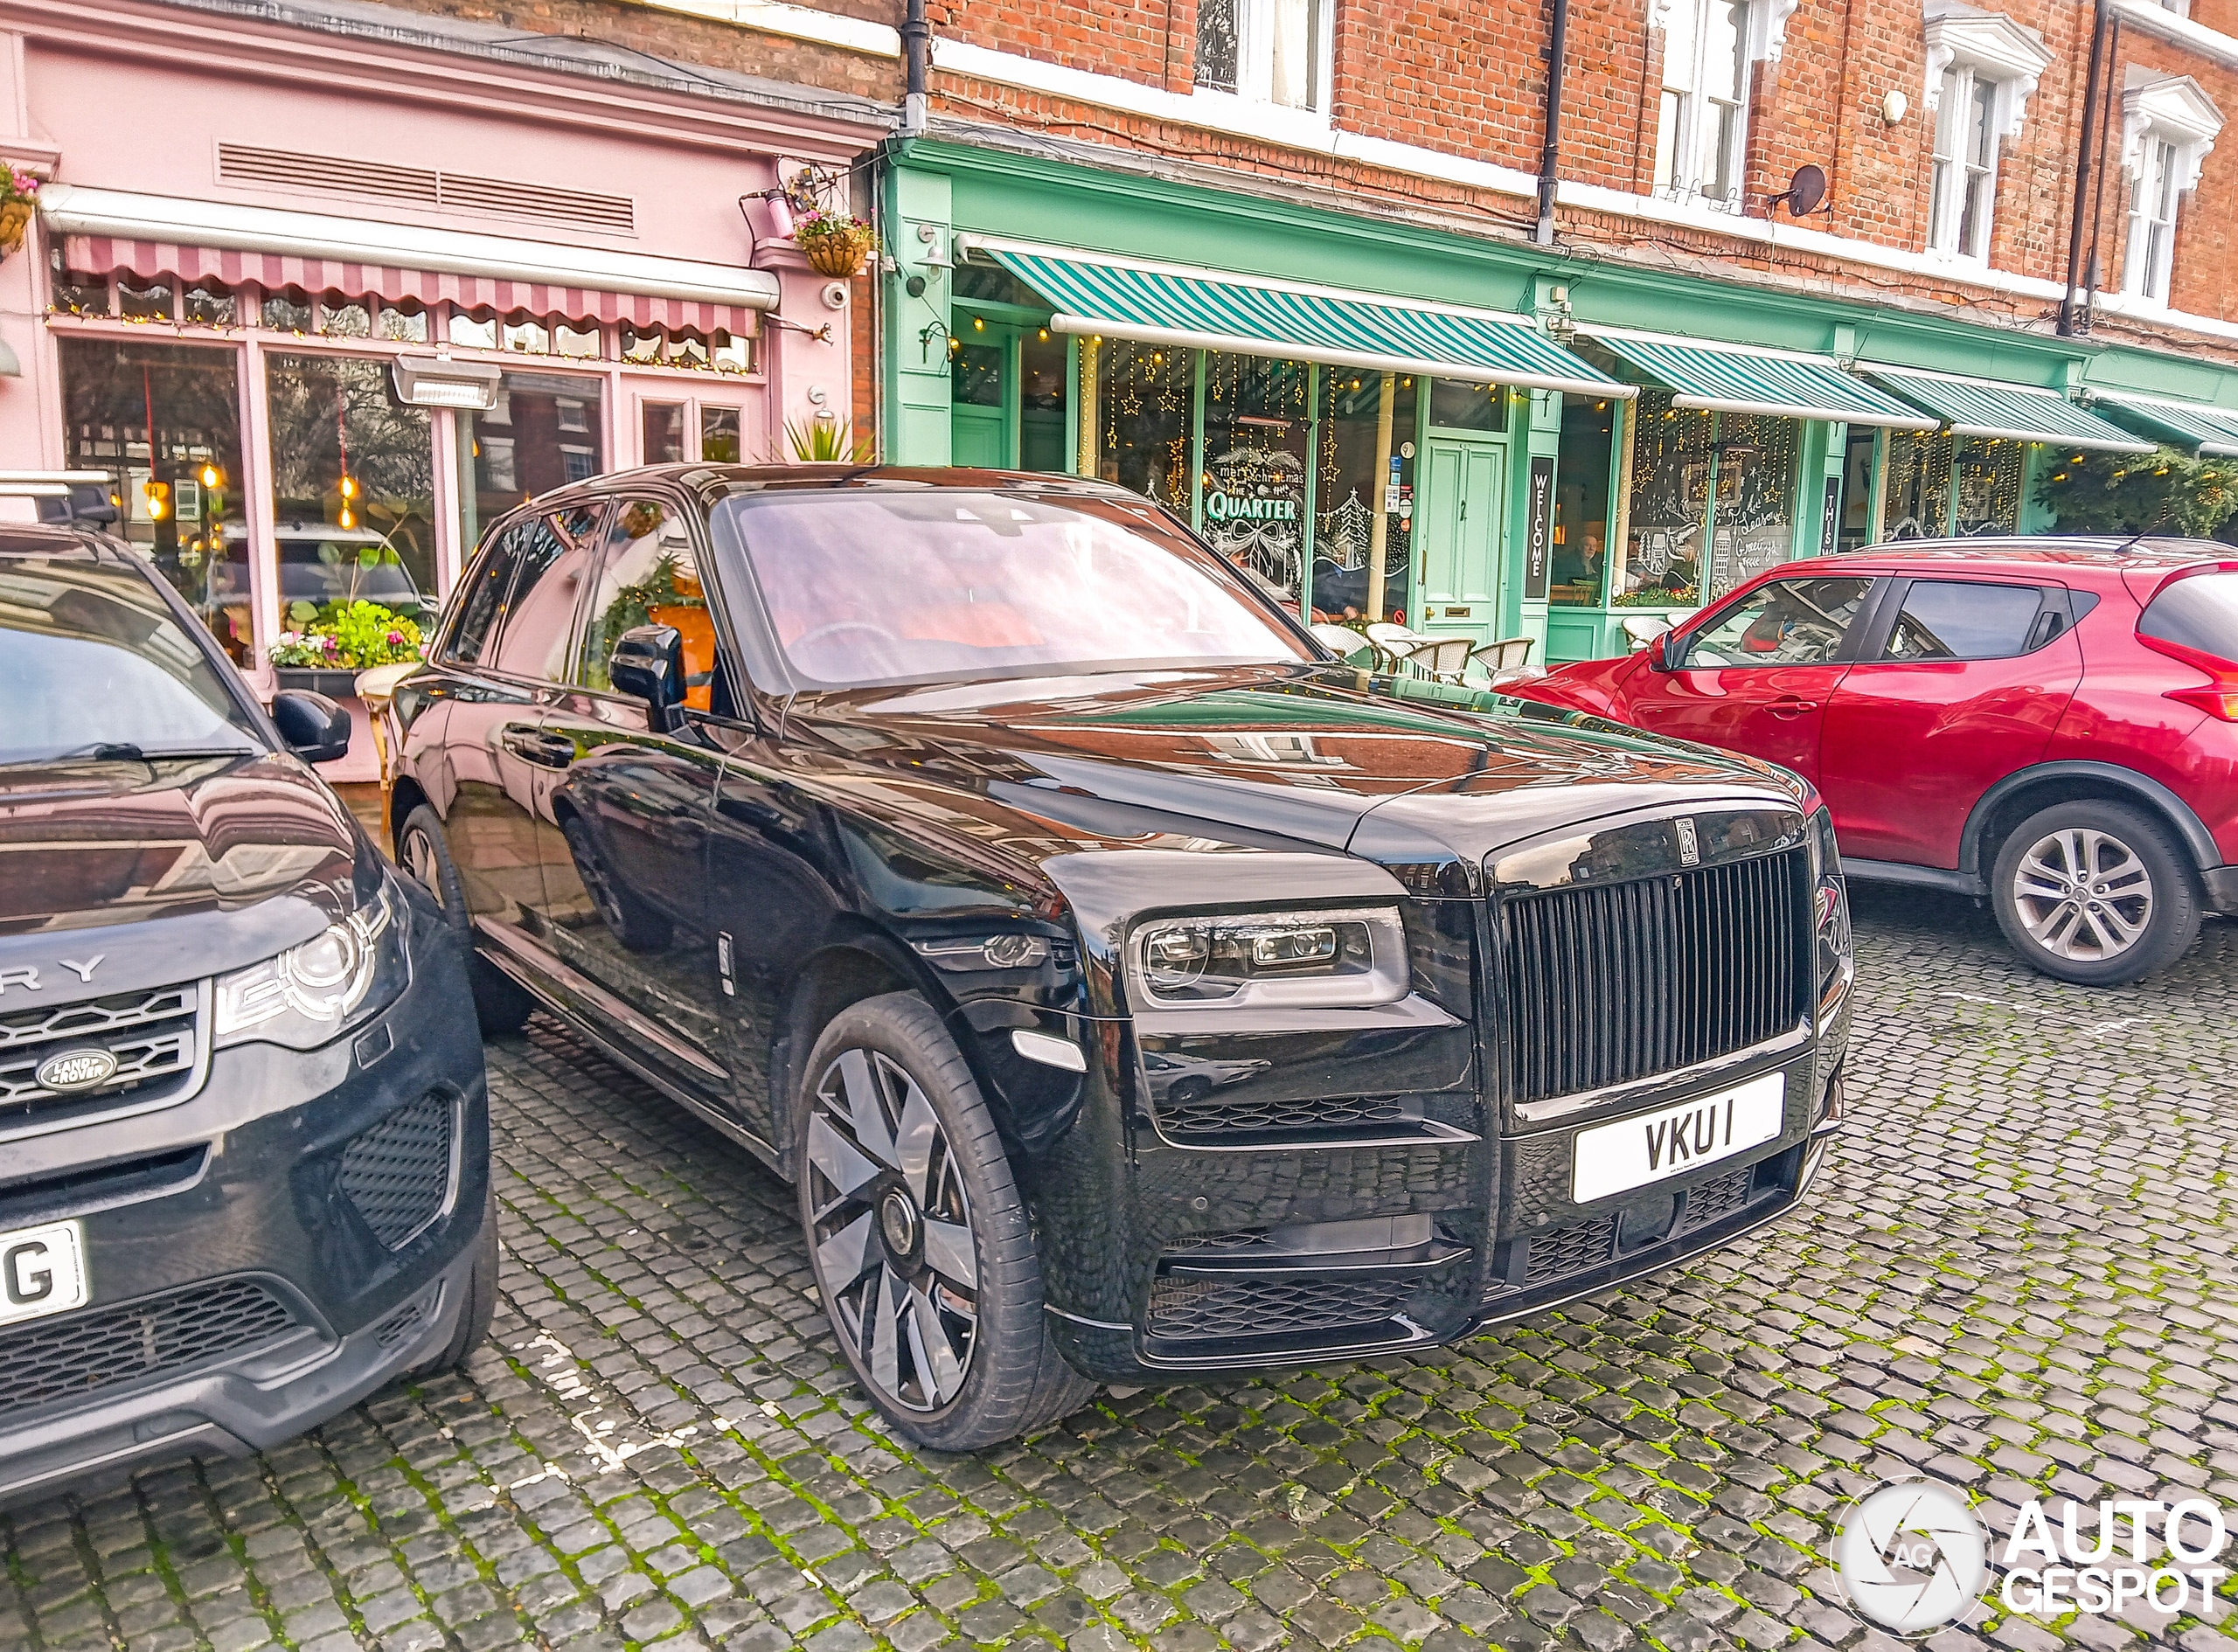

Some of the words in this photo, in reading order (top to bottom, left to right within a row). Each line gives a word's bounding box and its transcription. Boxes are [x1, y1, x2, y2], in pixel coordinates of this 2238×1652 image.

[1206, 491, 1296, 522] QUARTER
[1532, 474, 1548, 577] WELCOME
[1825, 495, 1835, 545] THIS
[54, 1057, 91, 1075] LAND
[59, 1065, 104, 1084] ROVER
[3, 1241, 52, 1306] G
